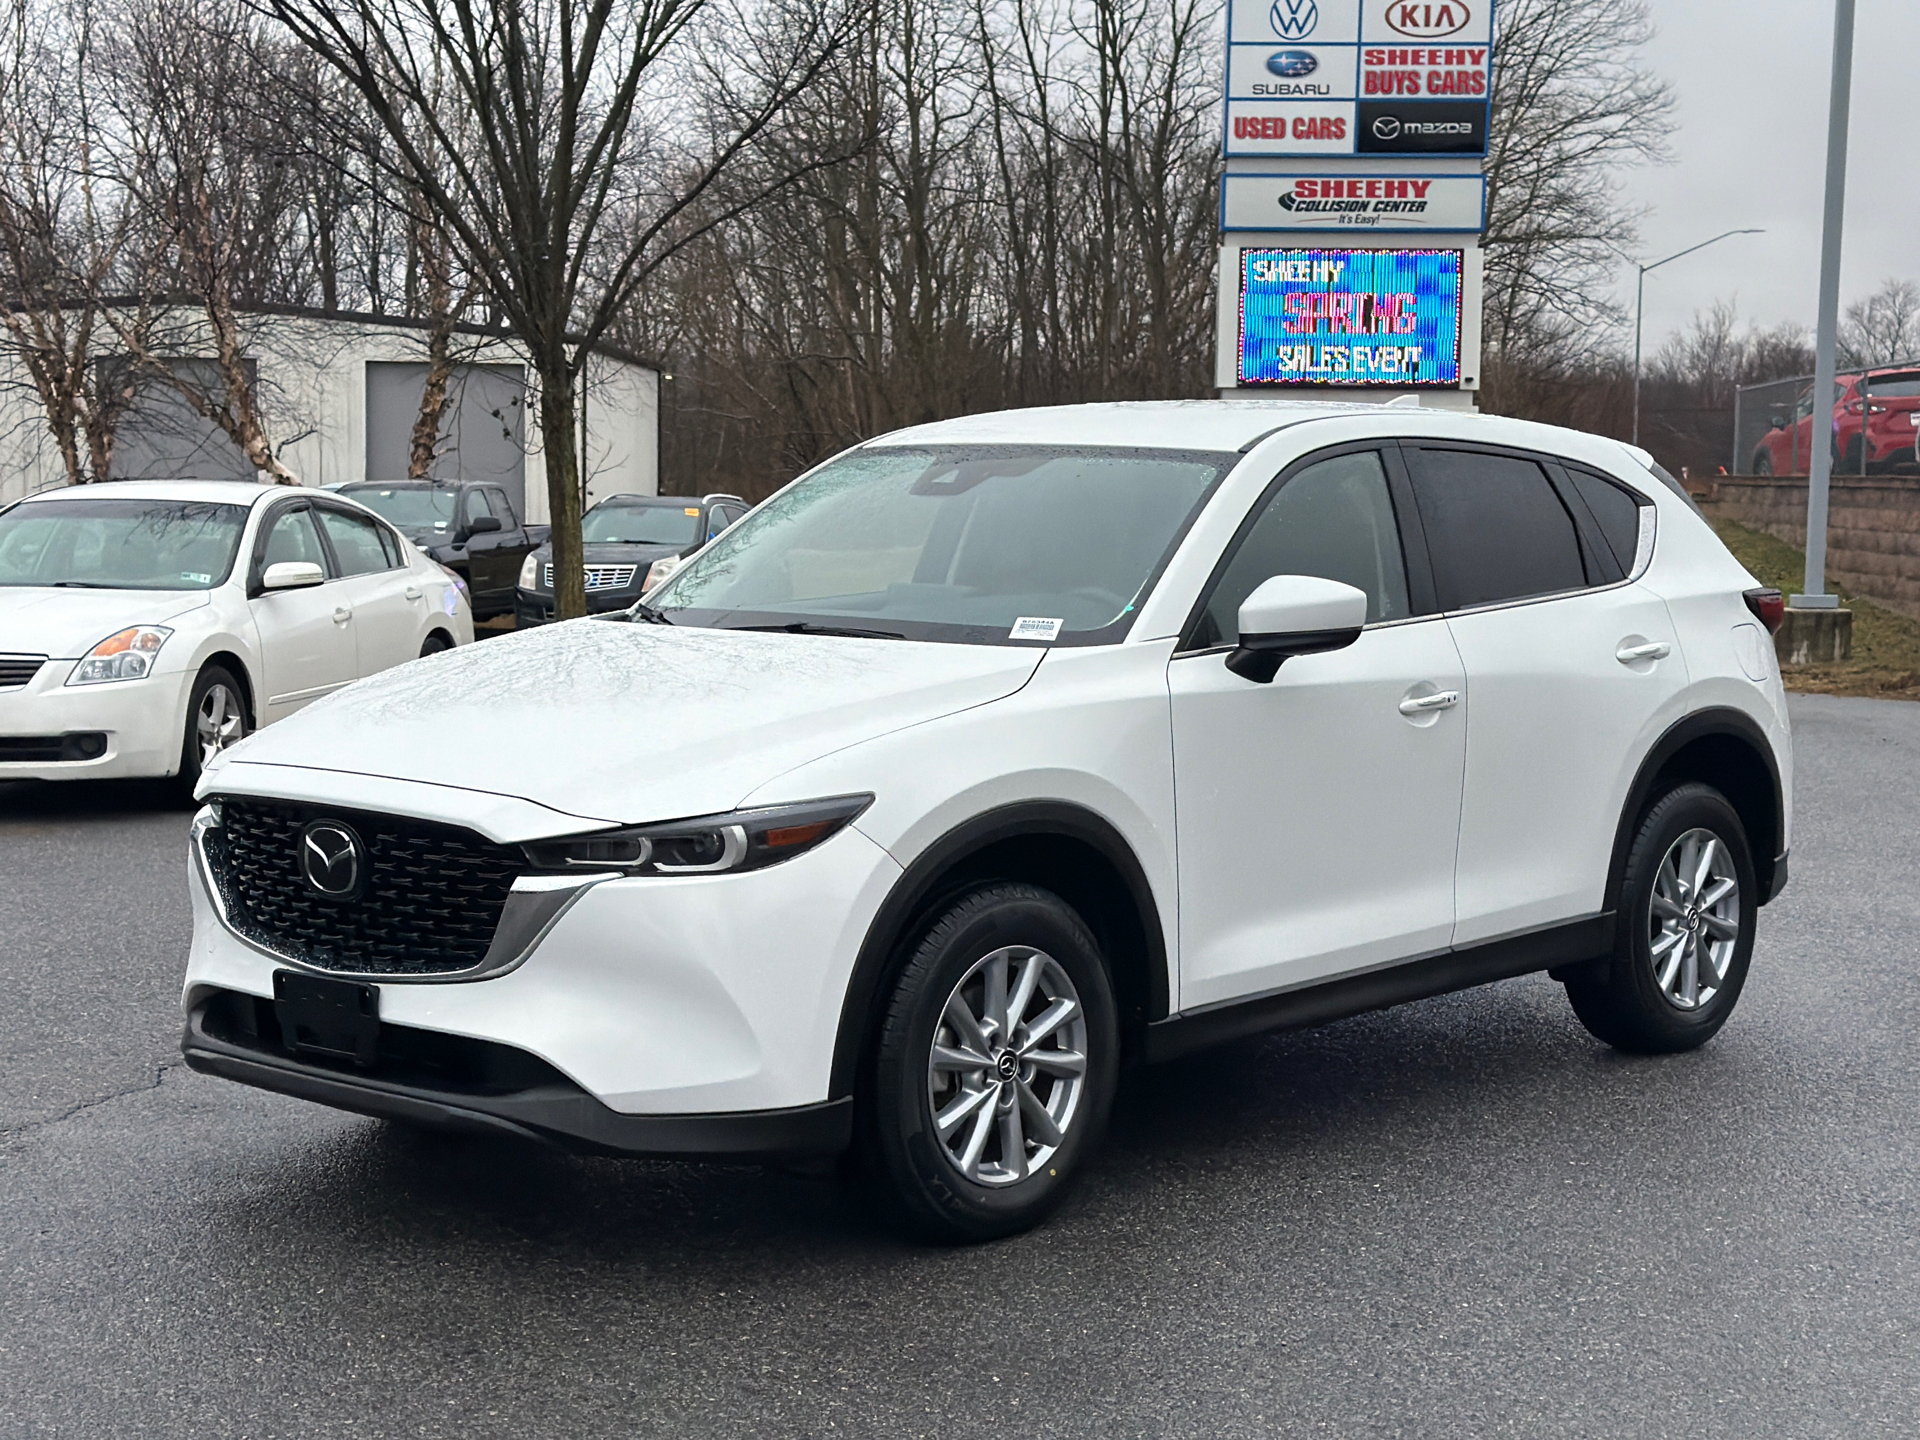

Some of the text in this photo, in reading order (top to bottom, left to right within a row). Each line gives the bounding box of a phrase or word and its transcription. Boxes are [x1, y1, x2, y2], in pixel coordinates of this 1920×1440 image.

[1401, 5, 1455, 27] KIA
[1364, 49, 1486, 66] SHEEHY
[1252, 84, 1330, 95] SUBARU
[1365, 71, 1485, 95] BUYS CARS
[1234, 117, 1346, 140] USED CARS
[1404, 121, 1472, 134] mazda
[1294, 180, 1432, 198] SHEEHY
[1296, 201, 1427, 213] COLLISION CENTER
[1338, 214, 1380, 225] It's Easy!
[1253, 260, 1345, 282] SHEEHY
[1283, 292, 1417, 334] SPRING
[1277, 344, 1422, 373] SALES EVENT
